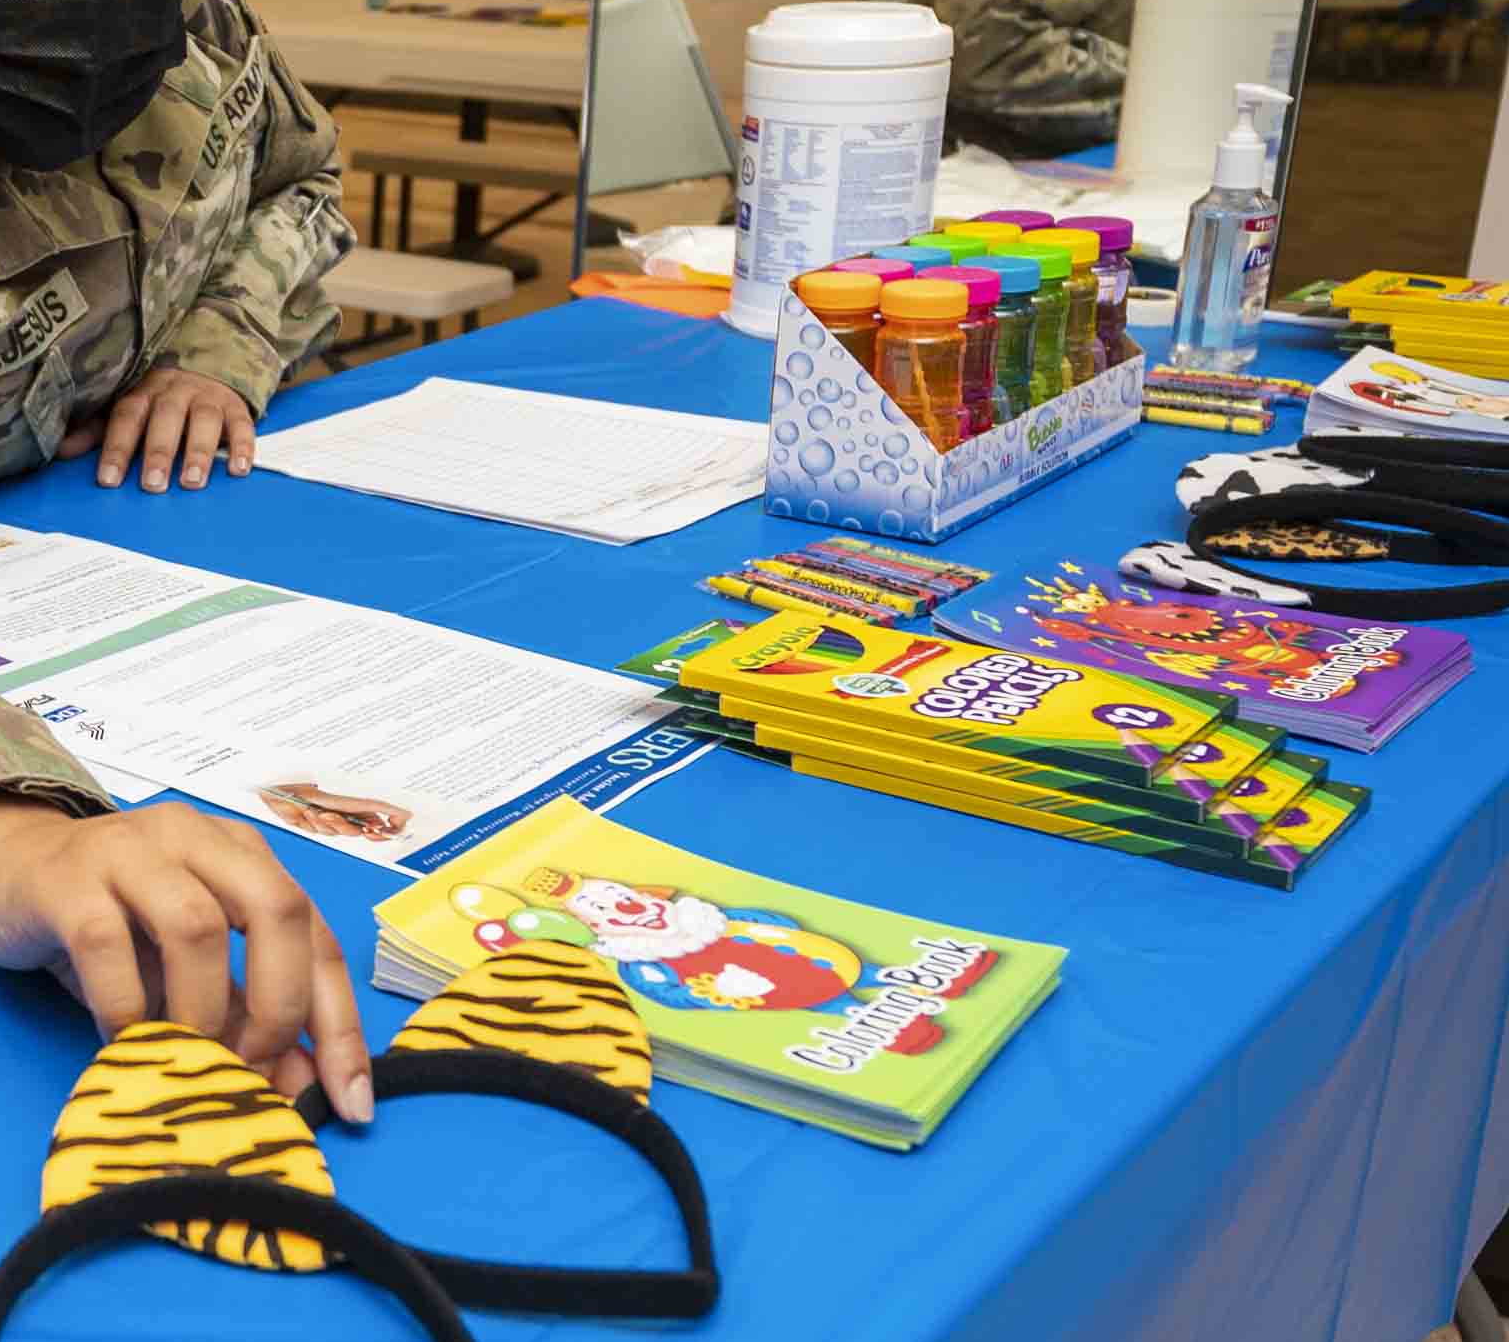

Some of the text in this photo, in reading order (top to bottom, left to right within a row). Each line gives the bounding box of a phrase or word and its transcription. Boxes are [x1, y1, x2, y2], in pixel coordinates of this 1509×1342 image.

[731, 625, 825, 667] Crayola
[1270, 625, 1408, 705] Coloring Book
[915, 654, 1031, 717] COLORED
[961, 665, 1084, 725] PENCILS
[1106, 704, 1159, 729] 12
[607, 725, 696, 771] ERS
[789, 940, 988, 1071] Coloring Book
